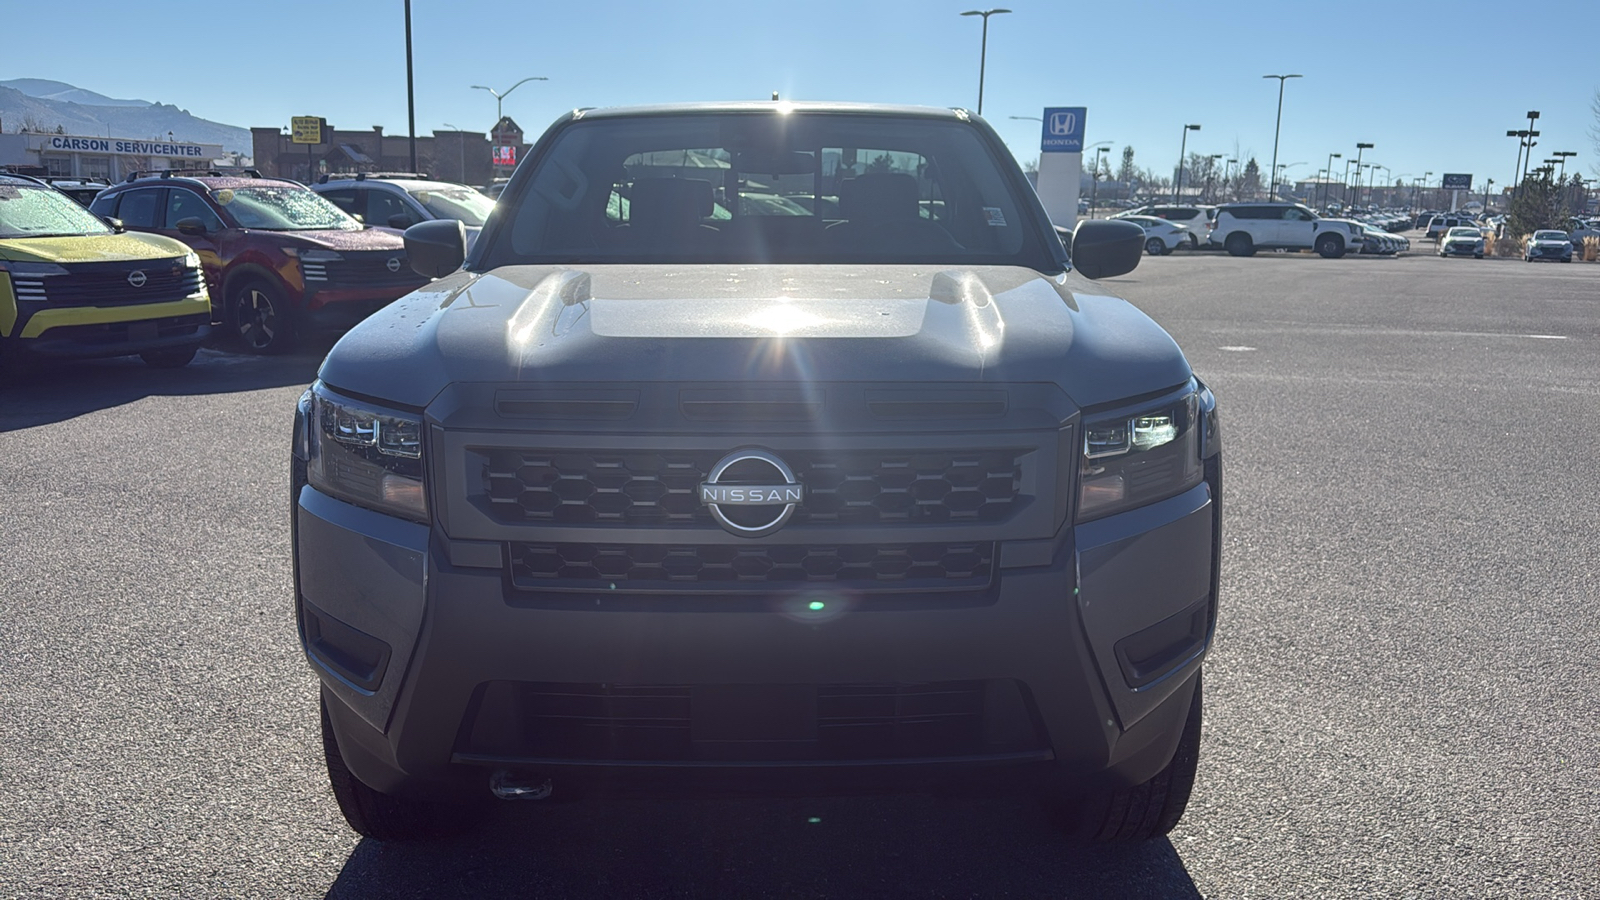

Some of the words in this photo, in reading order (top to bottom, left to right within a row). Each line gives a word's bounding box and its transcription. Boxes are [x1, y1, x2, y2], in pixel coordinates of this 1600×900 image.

[52, 137, 109, 151] CARSON
[115, 141, 202, 156] SERVICENTER
[703, 488, 800, 502] NISSAN
